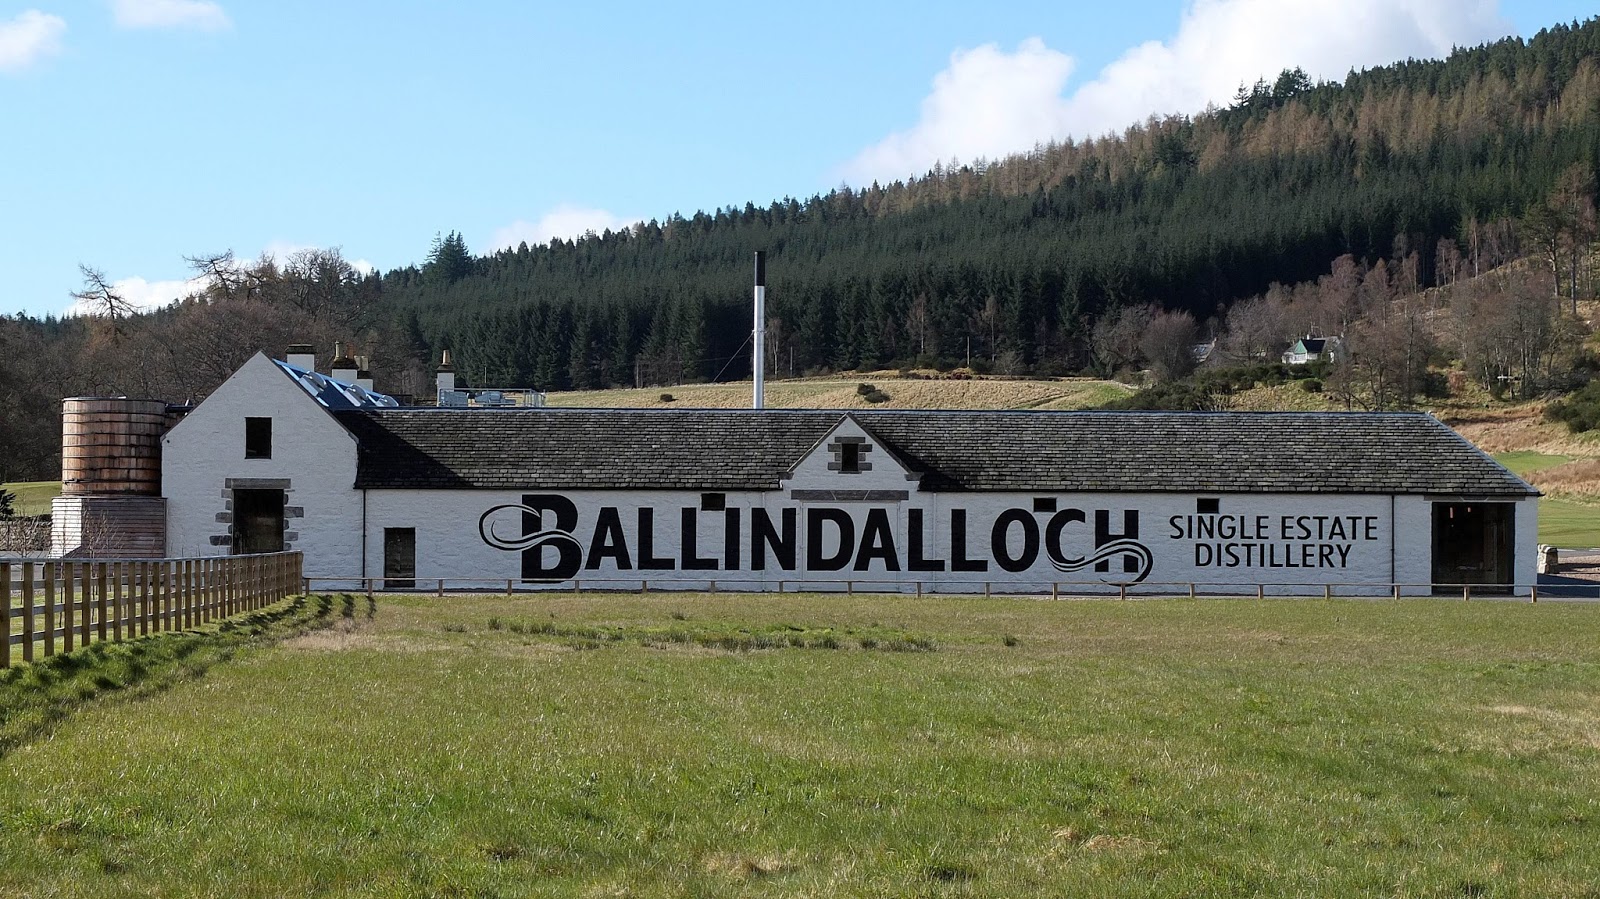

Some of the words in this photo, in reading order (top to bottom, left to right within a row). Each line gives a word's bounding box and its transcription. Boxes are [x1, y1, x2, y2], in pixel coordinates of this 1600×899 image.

[479, 493, 1152, 584] BALLINDALLOCH
[1169, 514, 1270, 541] SINGLE
[1280, 515, 1379, 541] ESTATE
[1194, 542, 1352, 569] DISTILLERY
